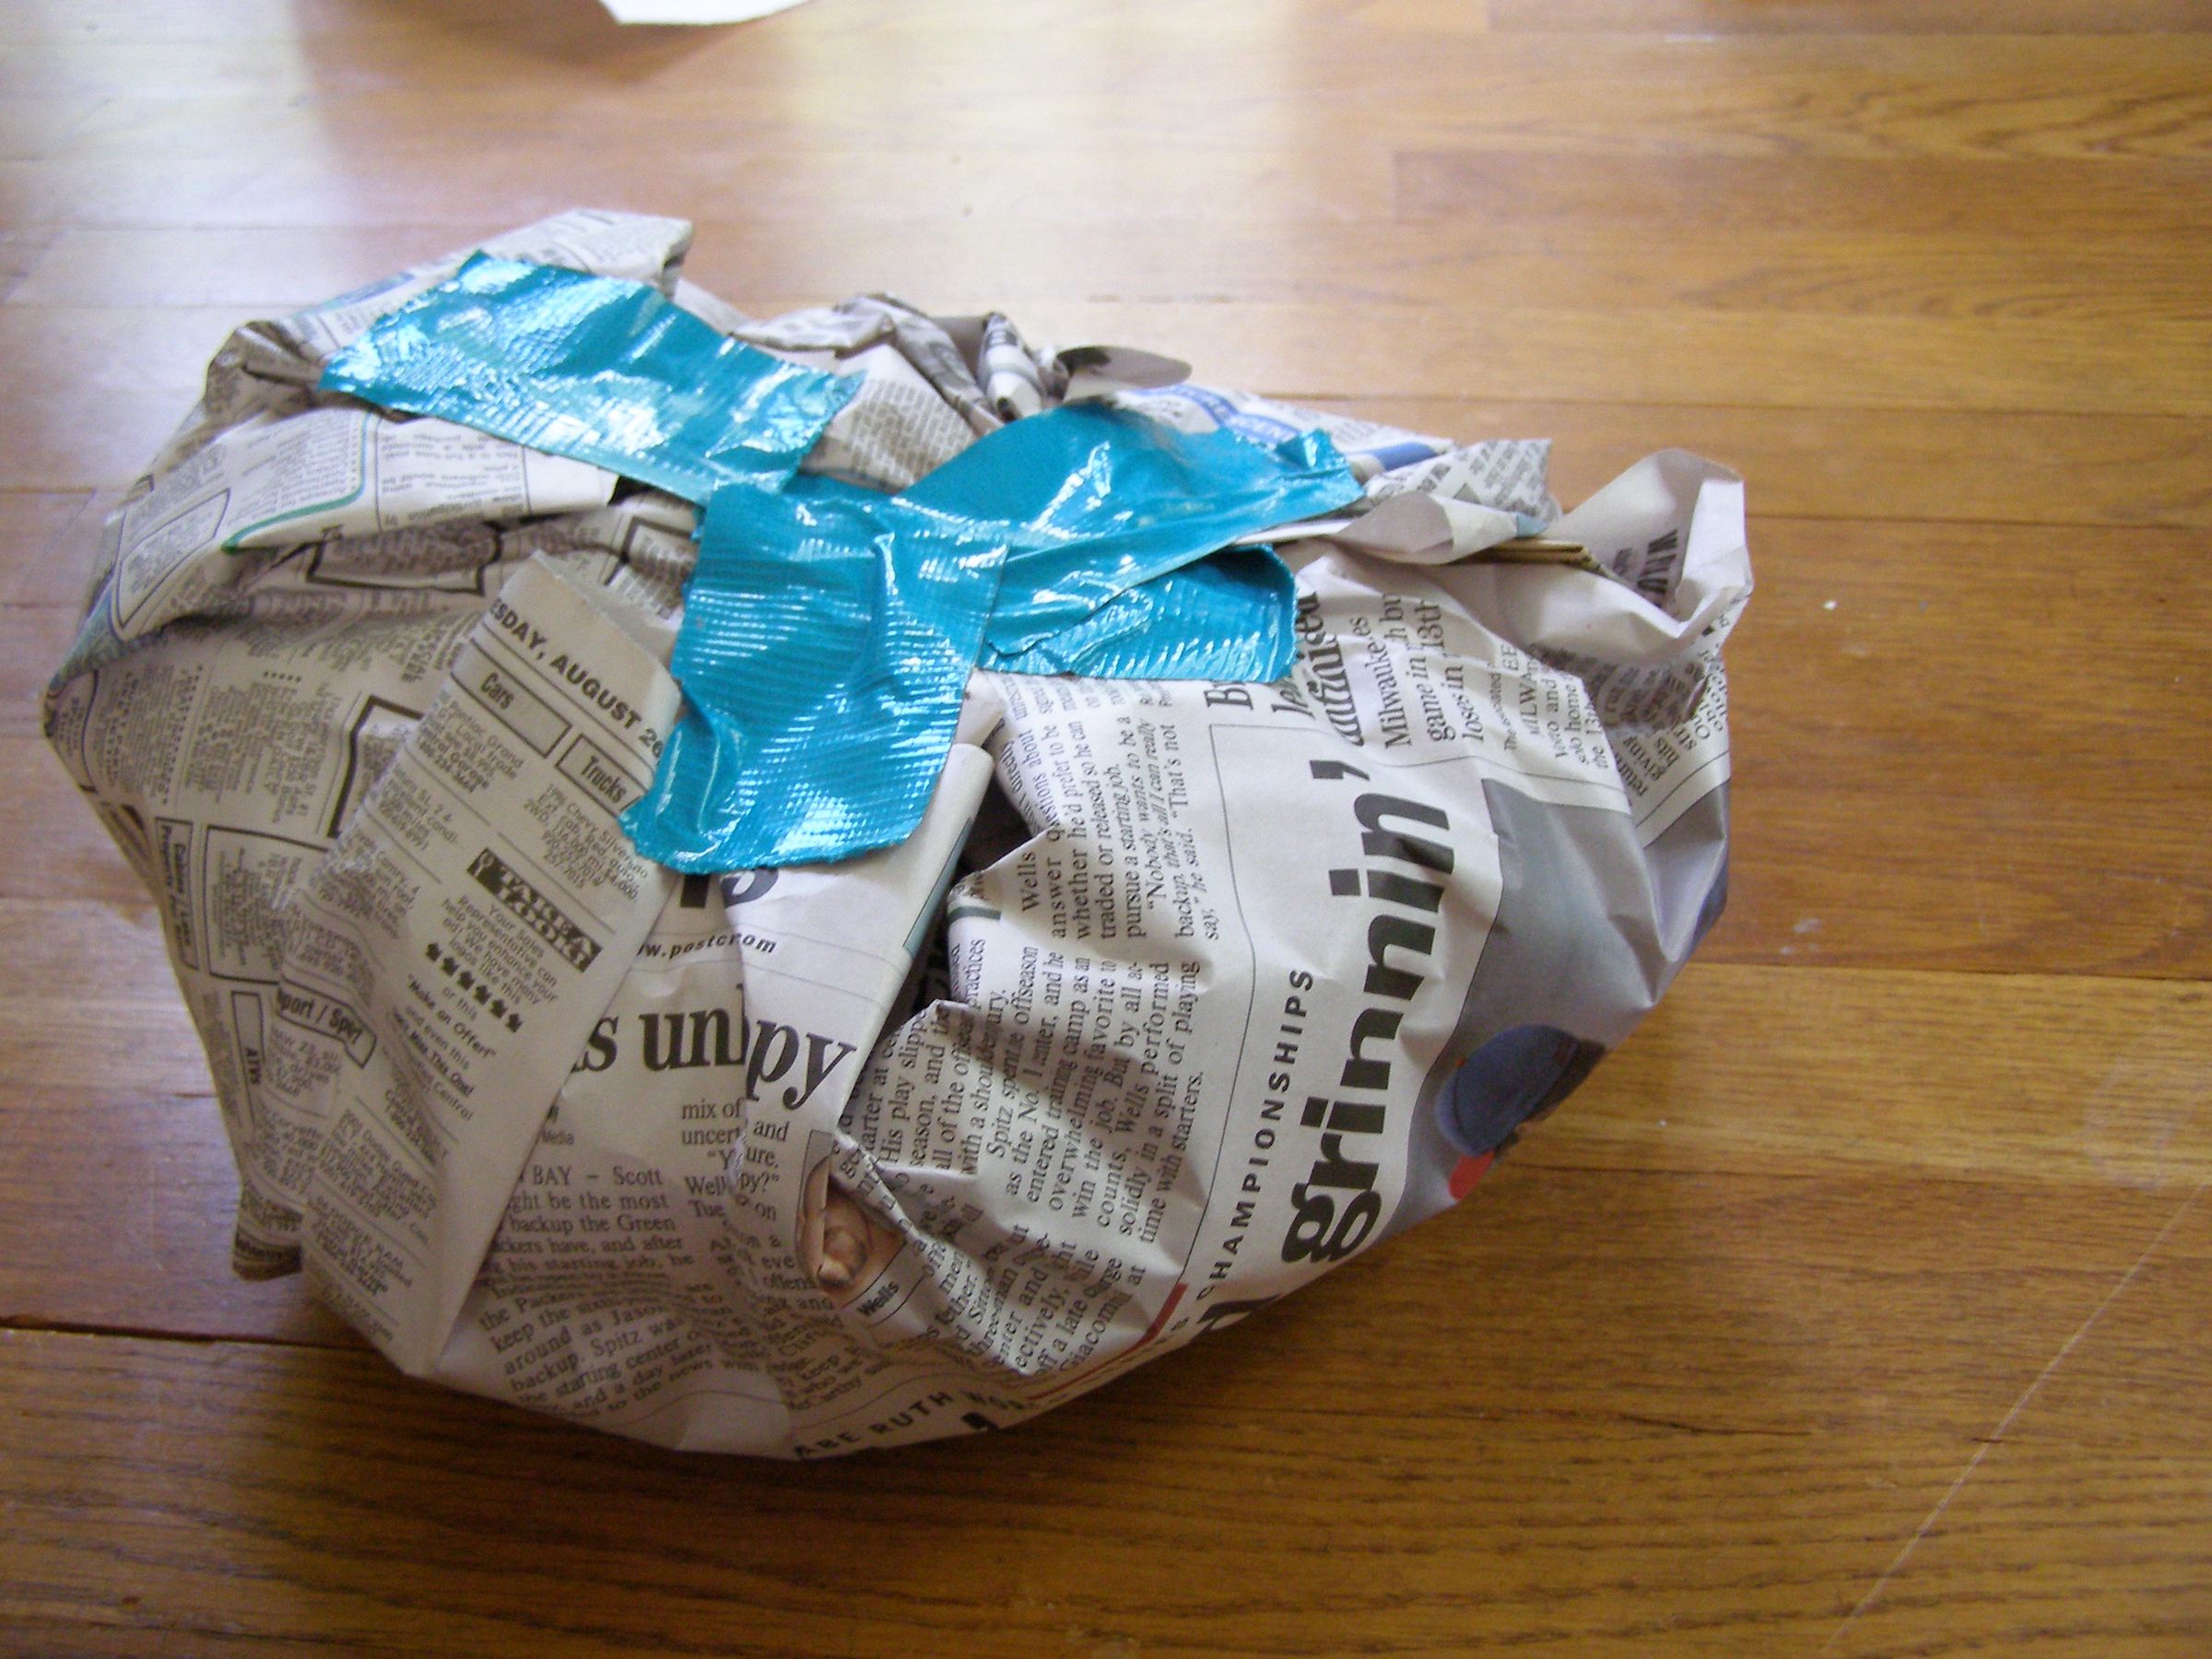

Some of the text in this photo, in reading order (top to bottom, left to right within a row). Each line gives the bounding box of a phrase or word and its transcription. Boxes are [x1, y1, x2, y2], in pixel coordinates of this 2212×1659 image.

[491, 598, 547, 660] SDAY,
[549, 654, 642, 729] AUGUST
[480, 672, 516, 711] Cars
[1405, 656, 1456, 743] game in
[1440, 665, 1485, 743] loses in
[1541, 678, 1559, 712] and
[1041, 724, 1060, 740] be
[1117, 715, 1132, 725] a
[1046, 741, 1065, 756] to
[1072, 742, 1093, 759] he
[1117, 729, 1137, 747] be
[1159, 724, 1180, 752] not
[1052, 759, 1084, 798] prefer
[1124, 752, 1141, 770] to
[1145, 763, 1162, 791] can
[582, 756, 628, 804] Trucks
[1082, 778, 1112, 839] released
[1127, 775, 1150, 822] wants
[1093, 843, 1114, 866] or
[1103, 763, 1147, 938] pursue a starting job.
[1016, 850, 1041, 912] Wells
[1045, 857, 1067, 938] answer
[1069, 848, 1091, 939] whether
[1094, 872, 1117, 938] traded
[1041, 971, 1063, 1006] and
[1071, 975, 1089, 994] as
[1121, 986, 1141, 1013] all
[1064, 999, 1089, 1055] camp
[1113, 1021, 1141, 1048] by
[923, 1043, 946, 1085] and
[985, 1105, 1014, 1159] Spitz
[1011, 946, 1039, 1025] offseason
[1113, 1084, 1150, 1134] Wells
[1138, 961, 1171, 1077] performed
[682, 1098, 717, 1120] mix
[942, 1081, 966, 1113] the
[1018, 1089, 1040, 1123] No.
[1118, 960, 1198, 1237] solidly in a split of playing
[753, 1120, 790, 1143] and
[879, 1076, 915, 1161] His play
[939, 1117, 957, 1143] of
[968, 1117, 986, 1129] a
[1090, 1098, 1118, 1134] job.
[1011, 1130, 1034, 1165] the
[1195, 968, 1314, 1300] CHAMPIONSHIPS
[1023, 1124, 1060, 1203] entered
[1083, 1136, 1104, 1171] the
[533, 1164, 664, 1186] BAY Scott
[1004, 1172, 1023, 1196] as
[547, 1191, 669, 1211] be the most
[1069, 1179, 1097, 1218] win
[509, 1214, 677, 1236] backup the Green
[1137, 1197, 1167, 1243] time
[504, 1325, 572, 1375] around
[591, 1330, 644, 1358] Spitz
[868, 1390, 955, 1435] RUTH
